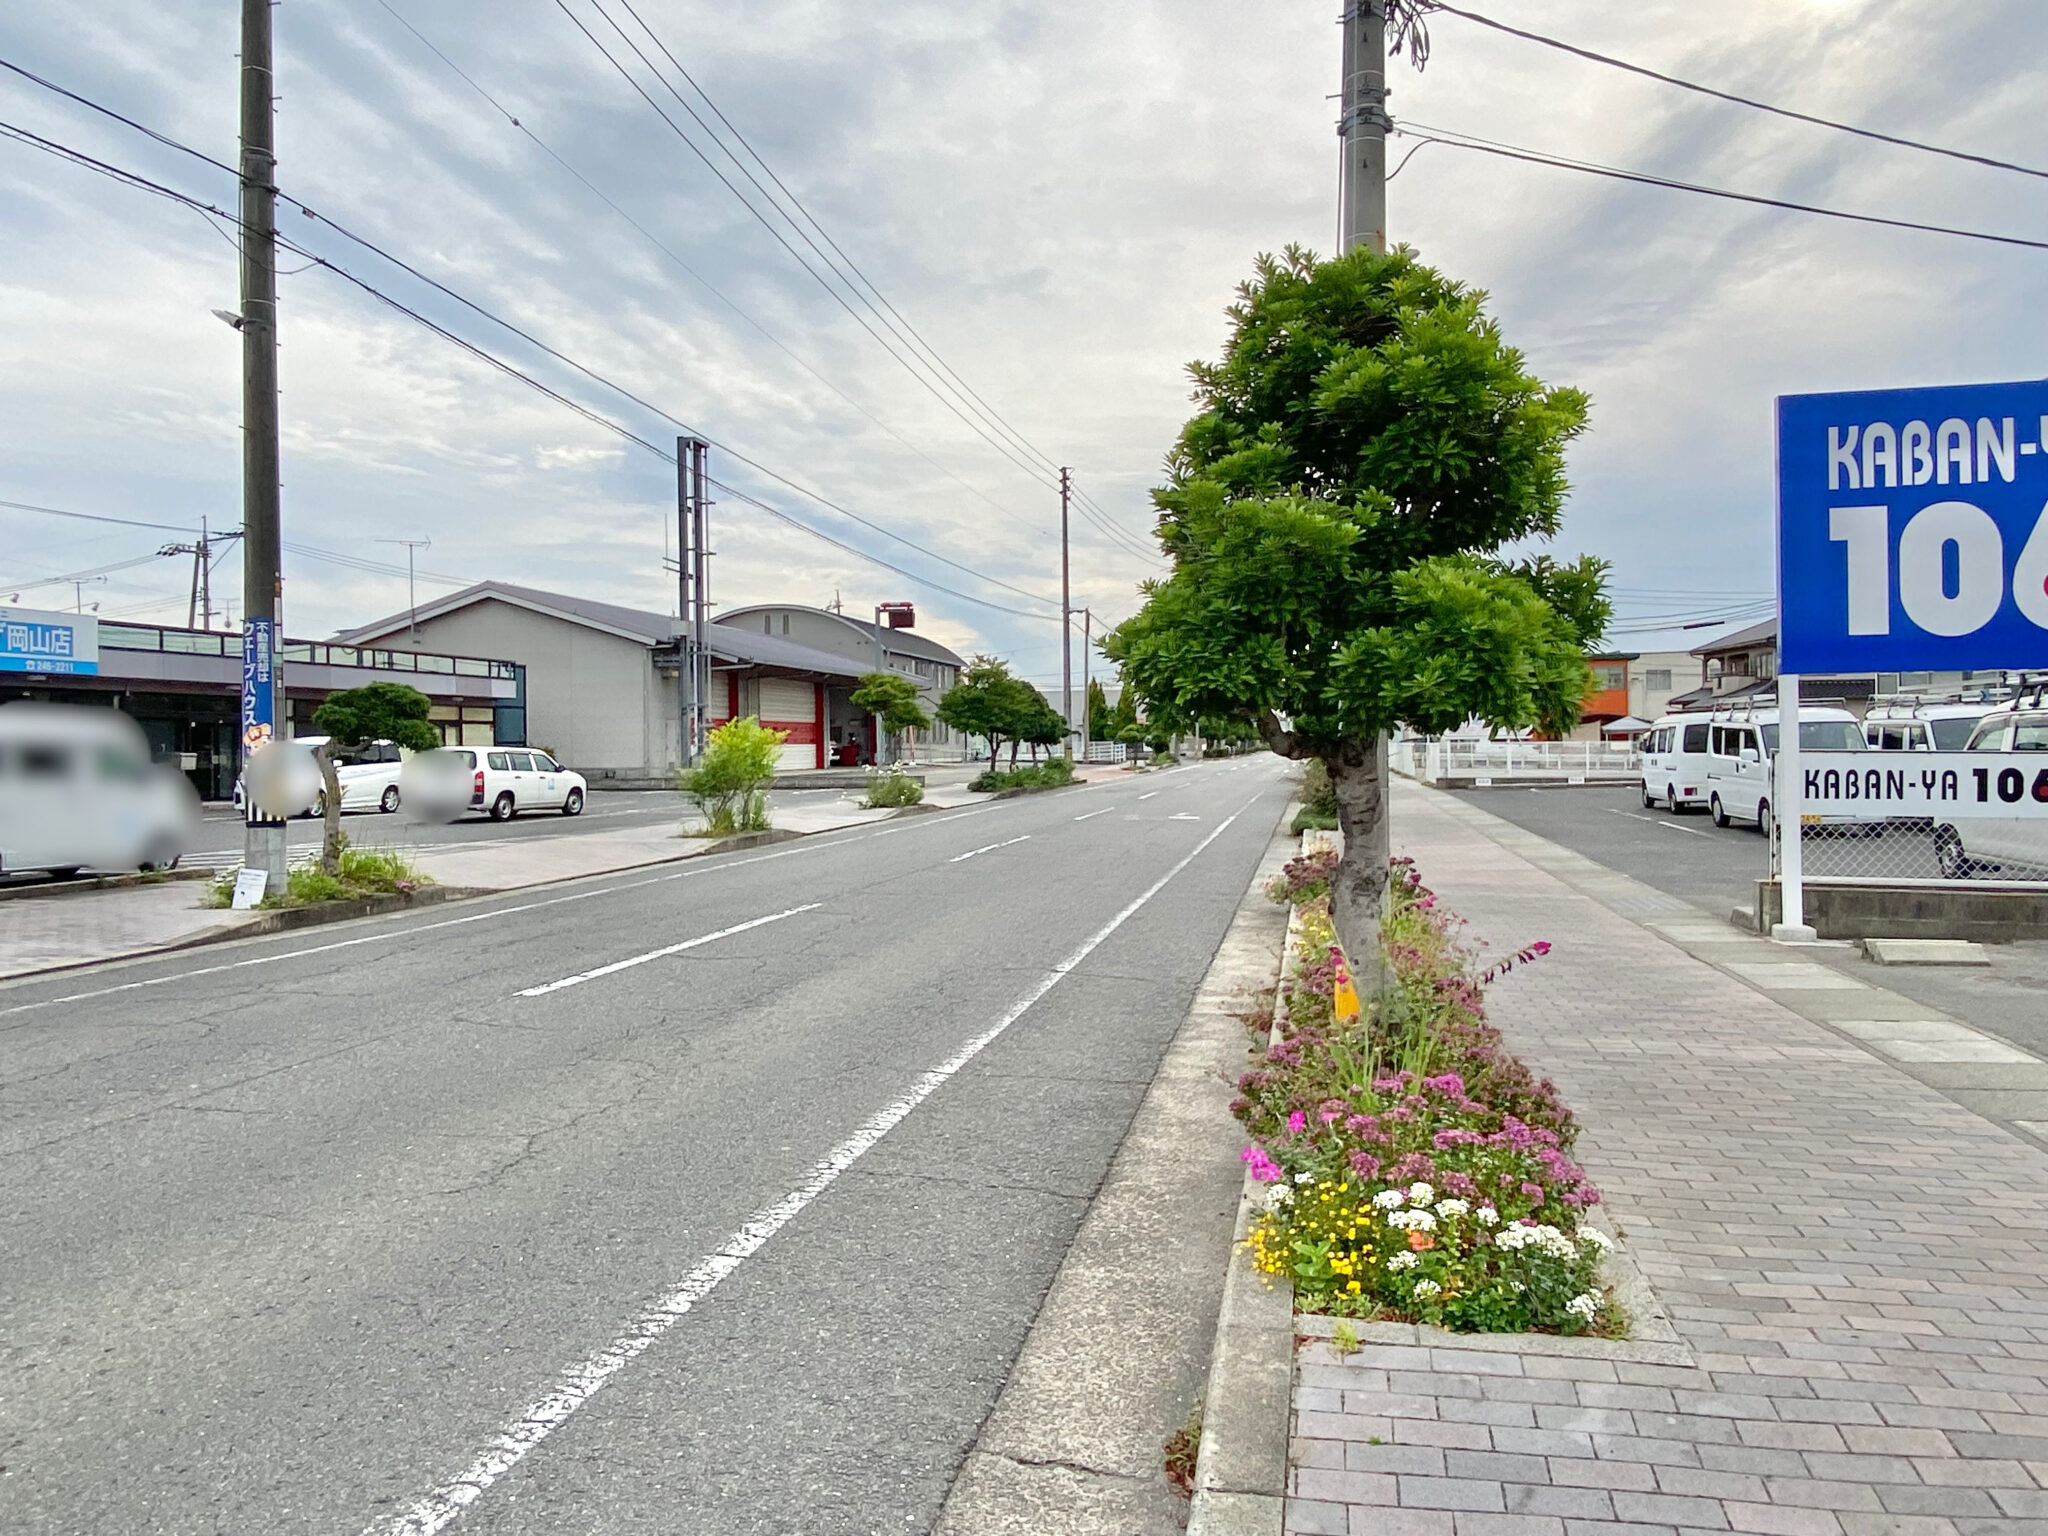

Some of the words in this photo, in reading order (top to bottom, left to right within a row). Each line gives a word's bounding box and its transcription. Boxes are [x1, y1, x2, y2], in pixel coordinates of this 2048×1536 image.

[1828, 415, 2048, 490] KABAN-
[0, 622, 71, 655] 岡山店
[256, 622, 270, 682] 不動産売却は
[1804, 769, 1958, 800] KABAN-YA
